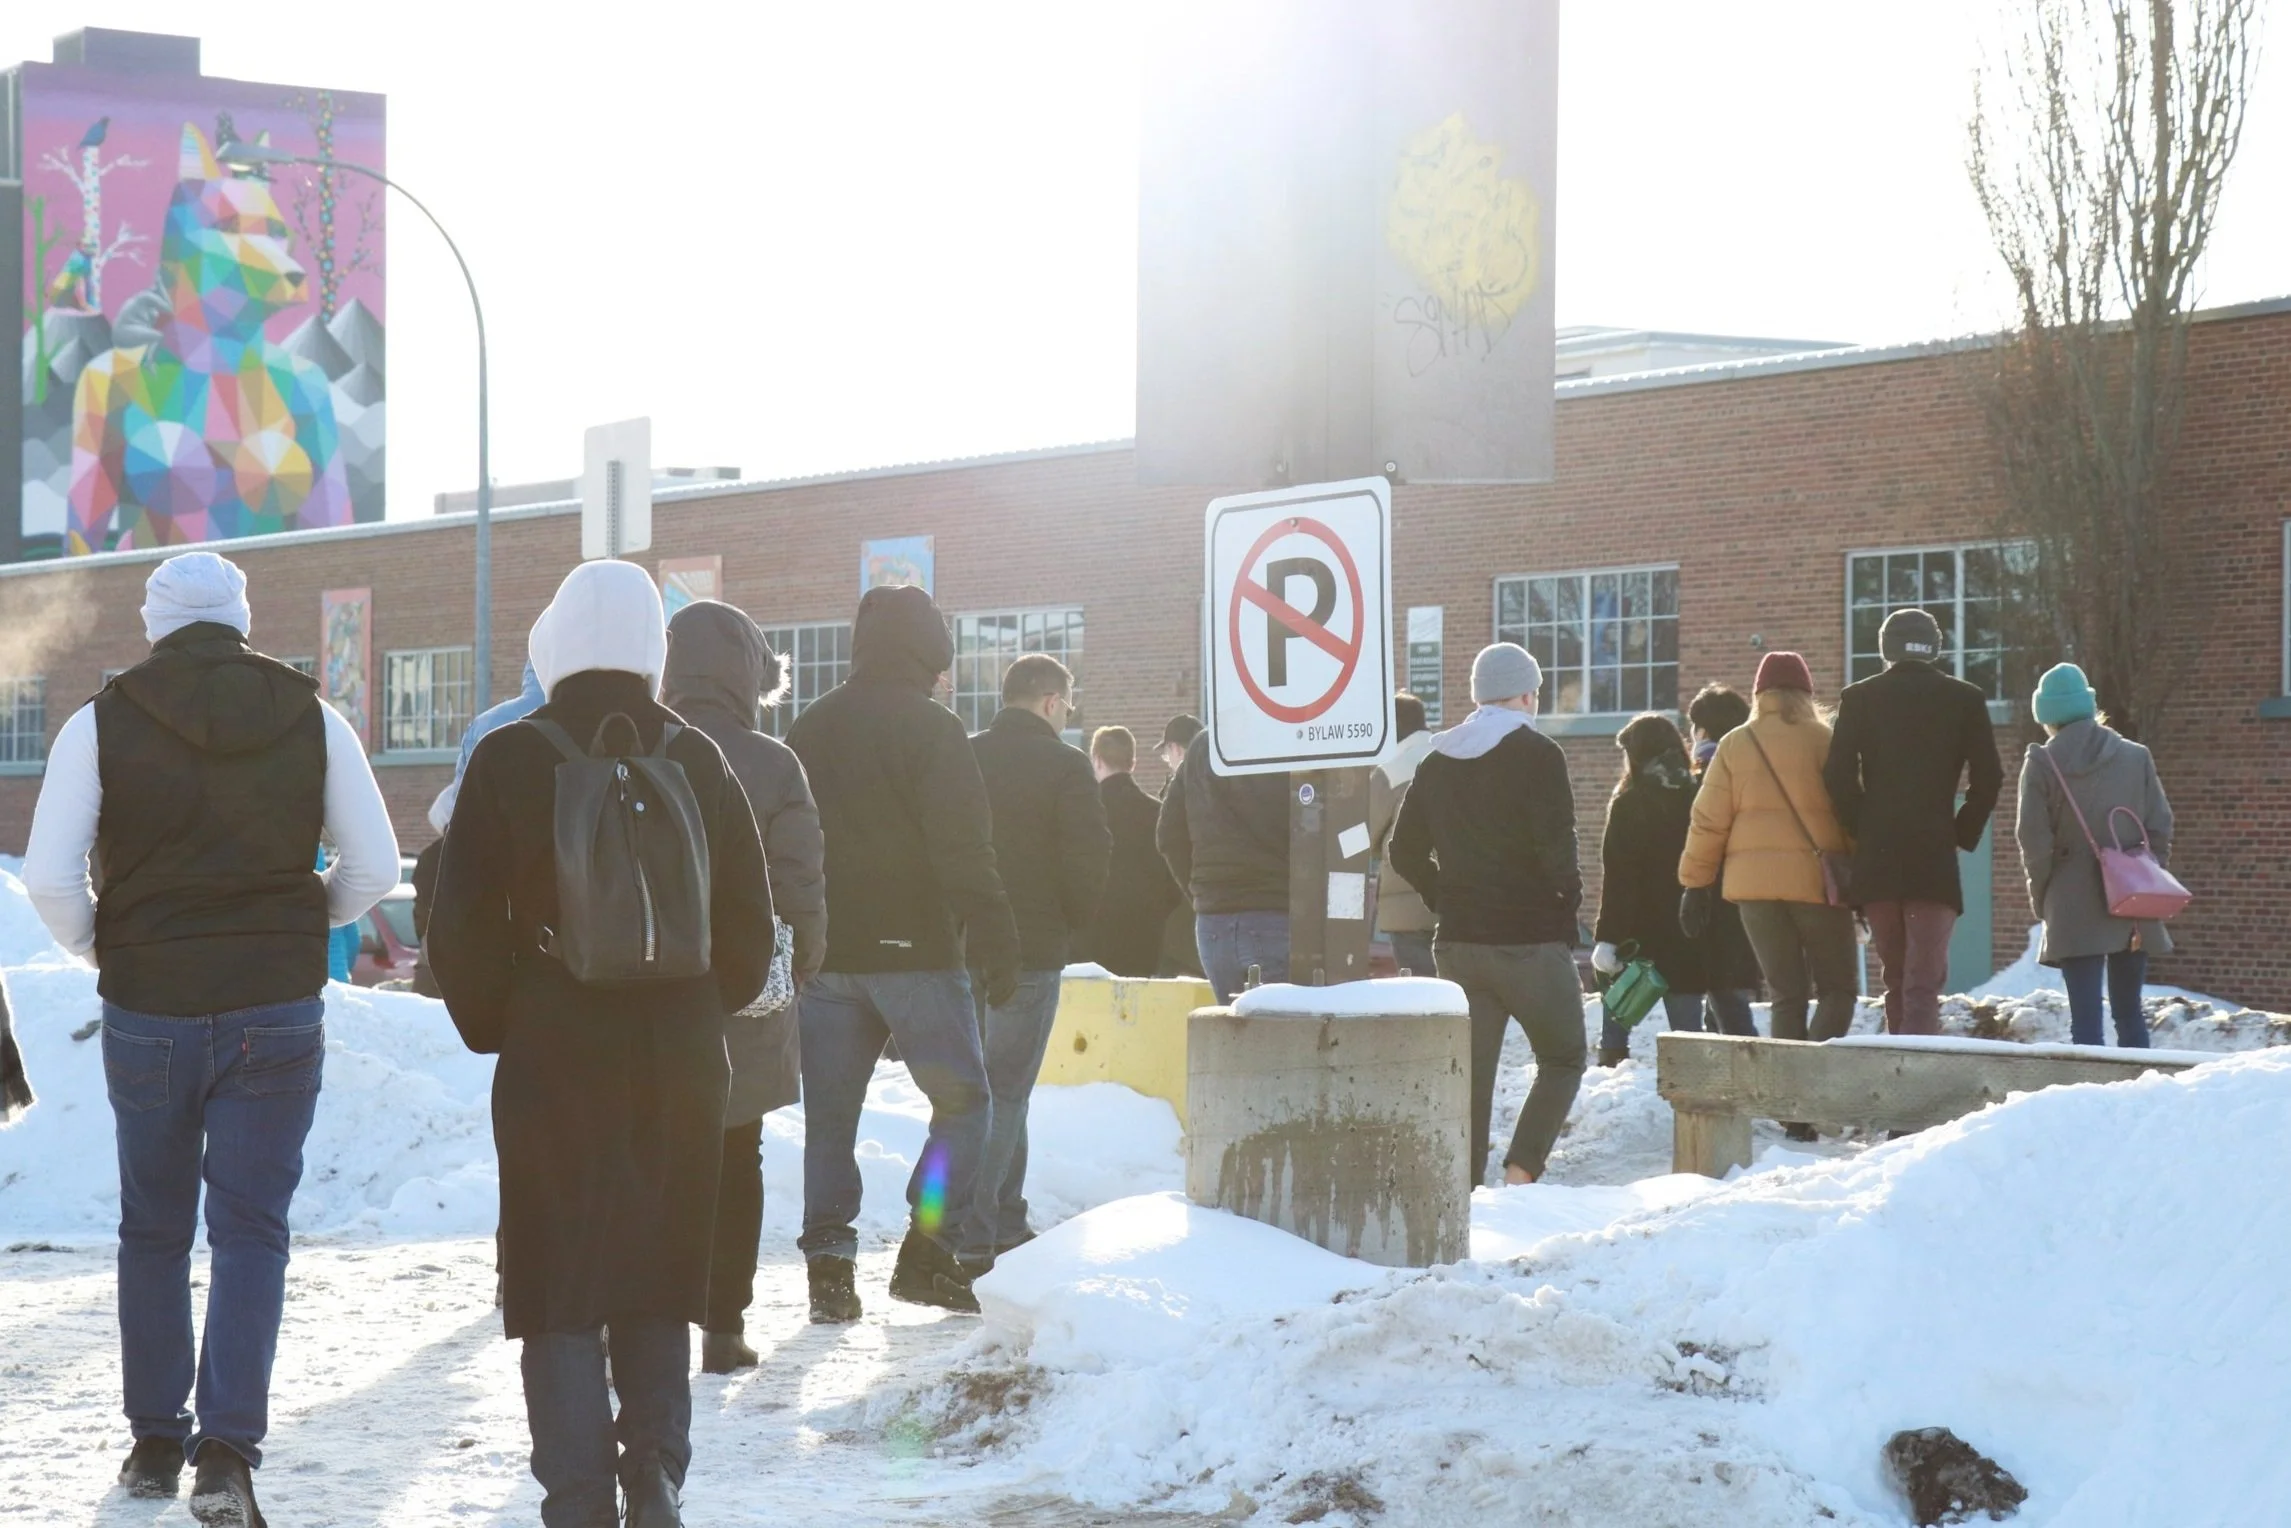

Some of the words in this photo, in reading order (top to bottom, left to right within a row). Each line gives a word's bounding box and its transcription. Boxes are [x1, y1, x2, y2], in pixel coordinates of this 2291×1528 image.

[1266, 557, 1337, 687] P
[1308, 724, 1345, 741] BYLAW
[1347, 722, 1373, 739] 5590
